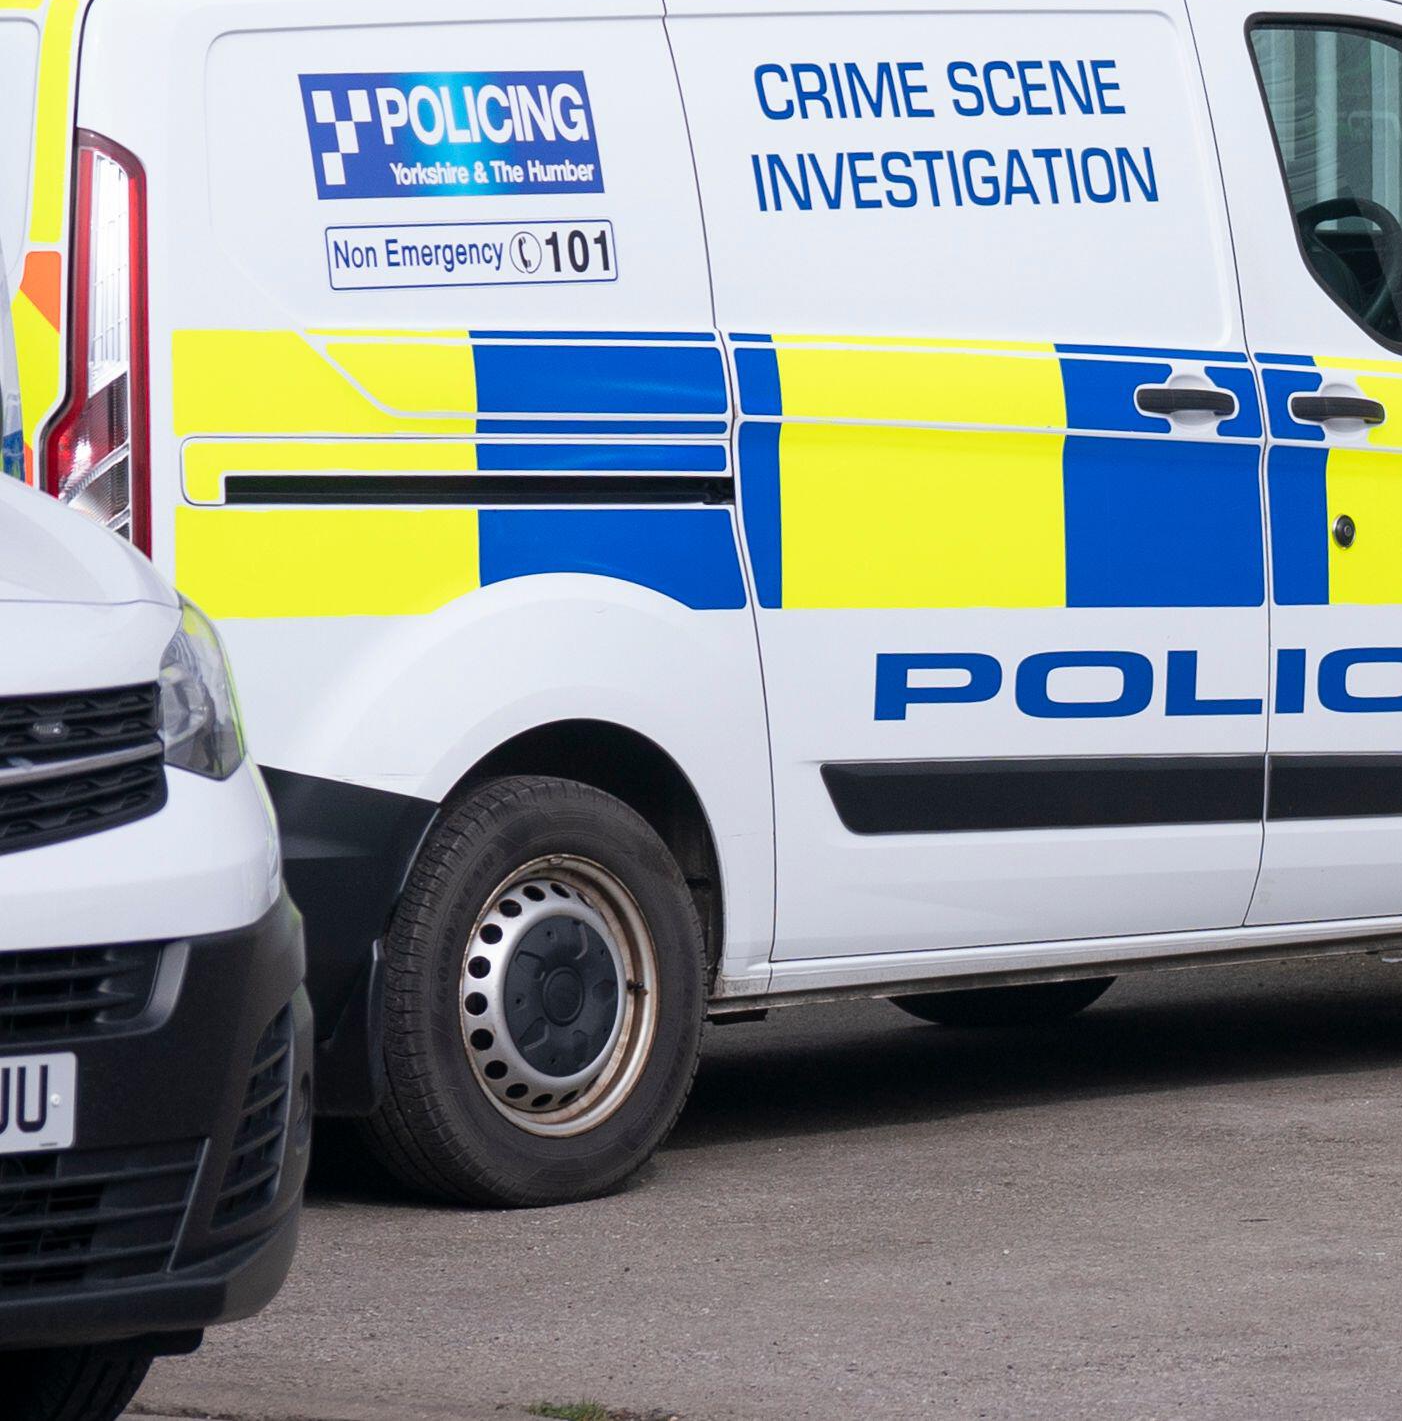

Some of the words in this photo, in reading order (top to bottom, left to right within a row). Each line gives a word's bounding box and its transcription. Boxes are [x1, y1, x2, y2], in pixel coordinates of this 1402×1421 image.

[375, 83, 591, 146] POLICING
[753, 61, 936, 121] CRIME
[946, 59, 1127, 117] SCENE
[389, 161, 470, 186] Yorkshire
[473, 161, 489, 184] &
[489, 160, 525, 183] The
[527, 158, 595, 182] Humber
[750, 146, 1160, 212] INVESTIGATION
[332, 240, 378, 269] Non
[385, 238, 504, 271] Emergency
[545, 230, 611, 273] 101
